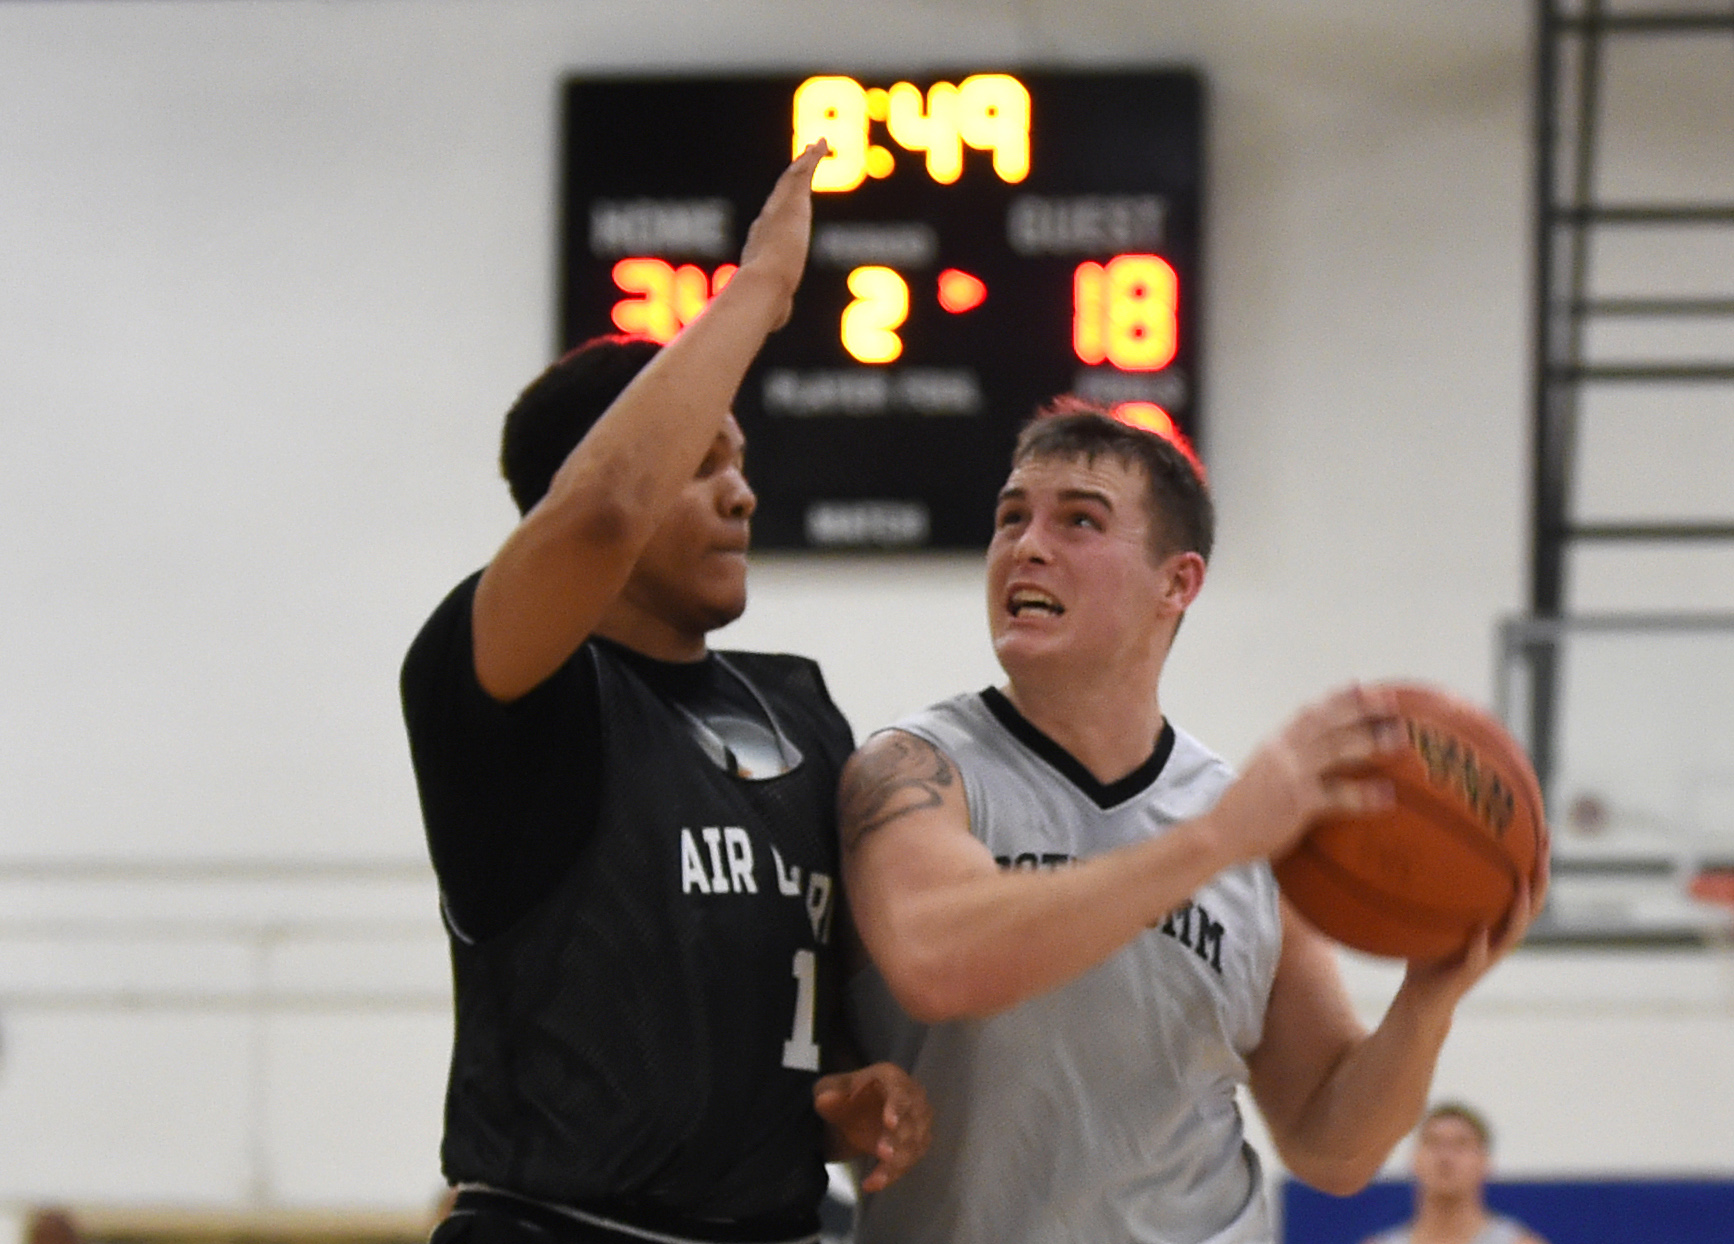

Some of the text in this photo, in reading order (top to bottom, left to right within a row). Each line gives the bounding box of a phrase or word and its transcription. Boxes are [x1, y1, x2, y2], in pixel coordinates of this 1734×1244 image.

[792, 73, 1031, 193] 8:49
[1010, 197, 1164, 253] GUEST
[840, 264, 910, 364] 2
[1072, 253, 1179, 372] 18
[681, 826, 758, 895] AIR
